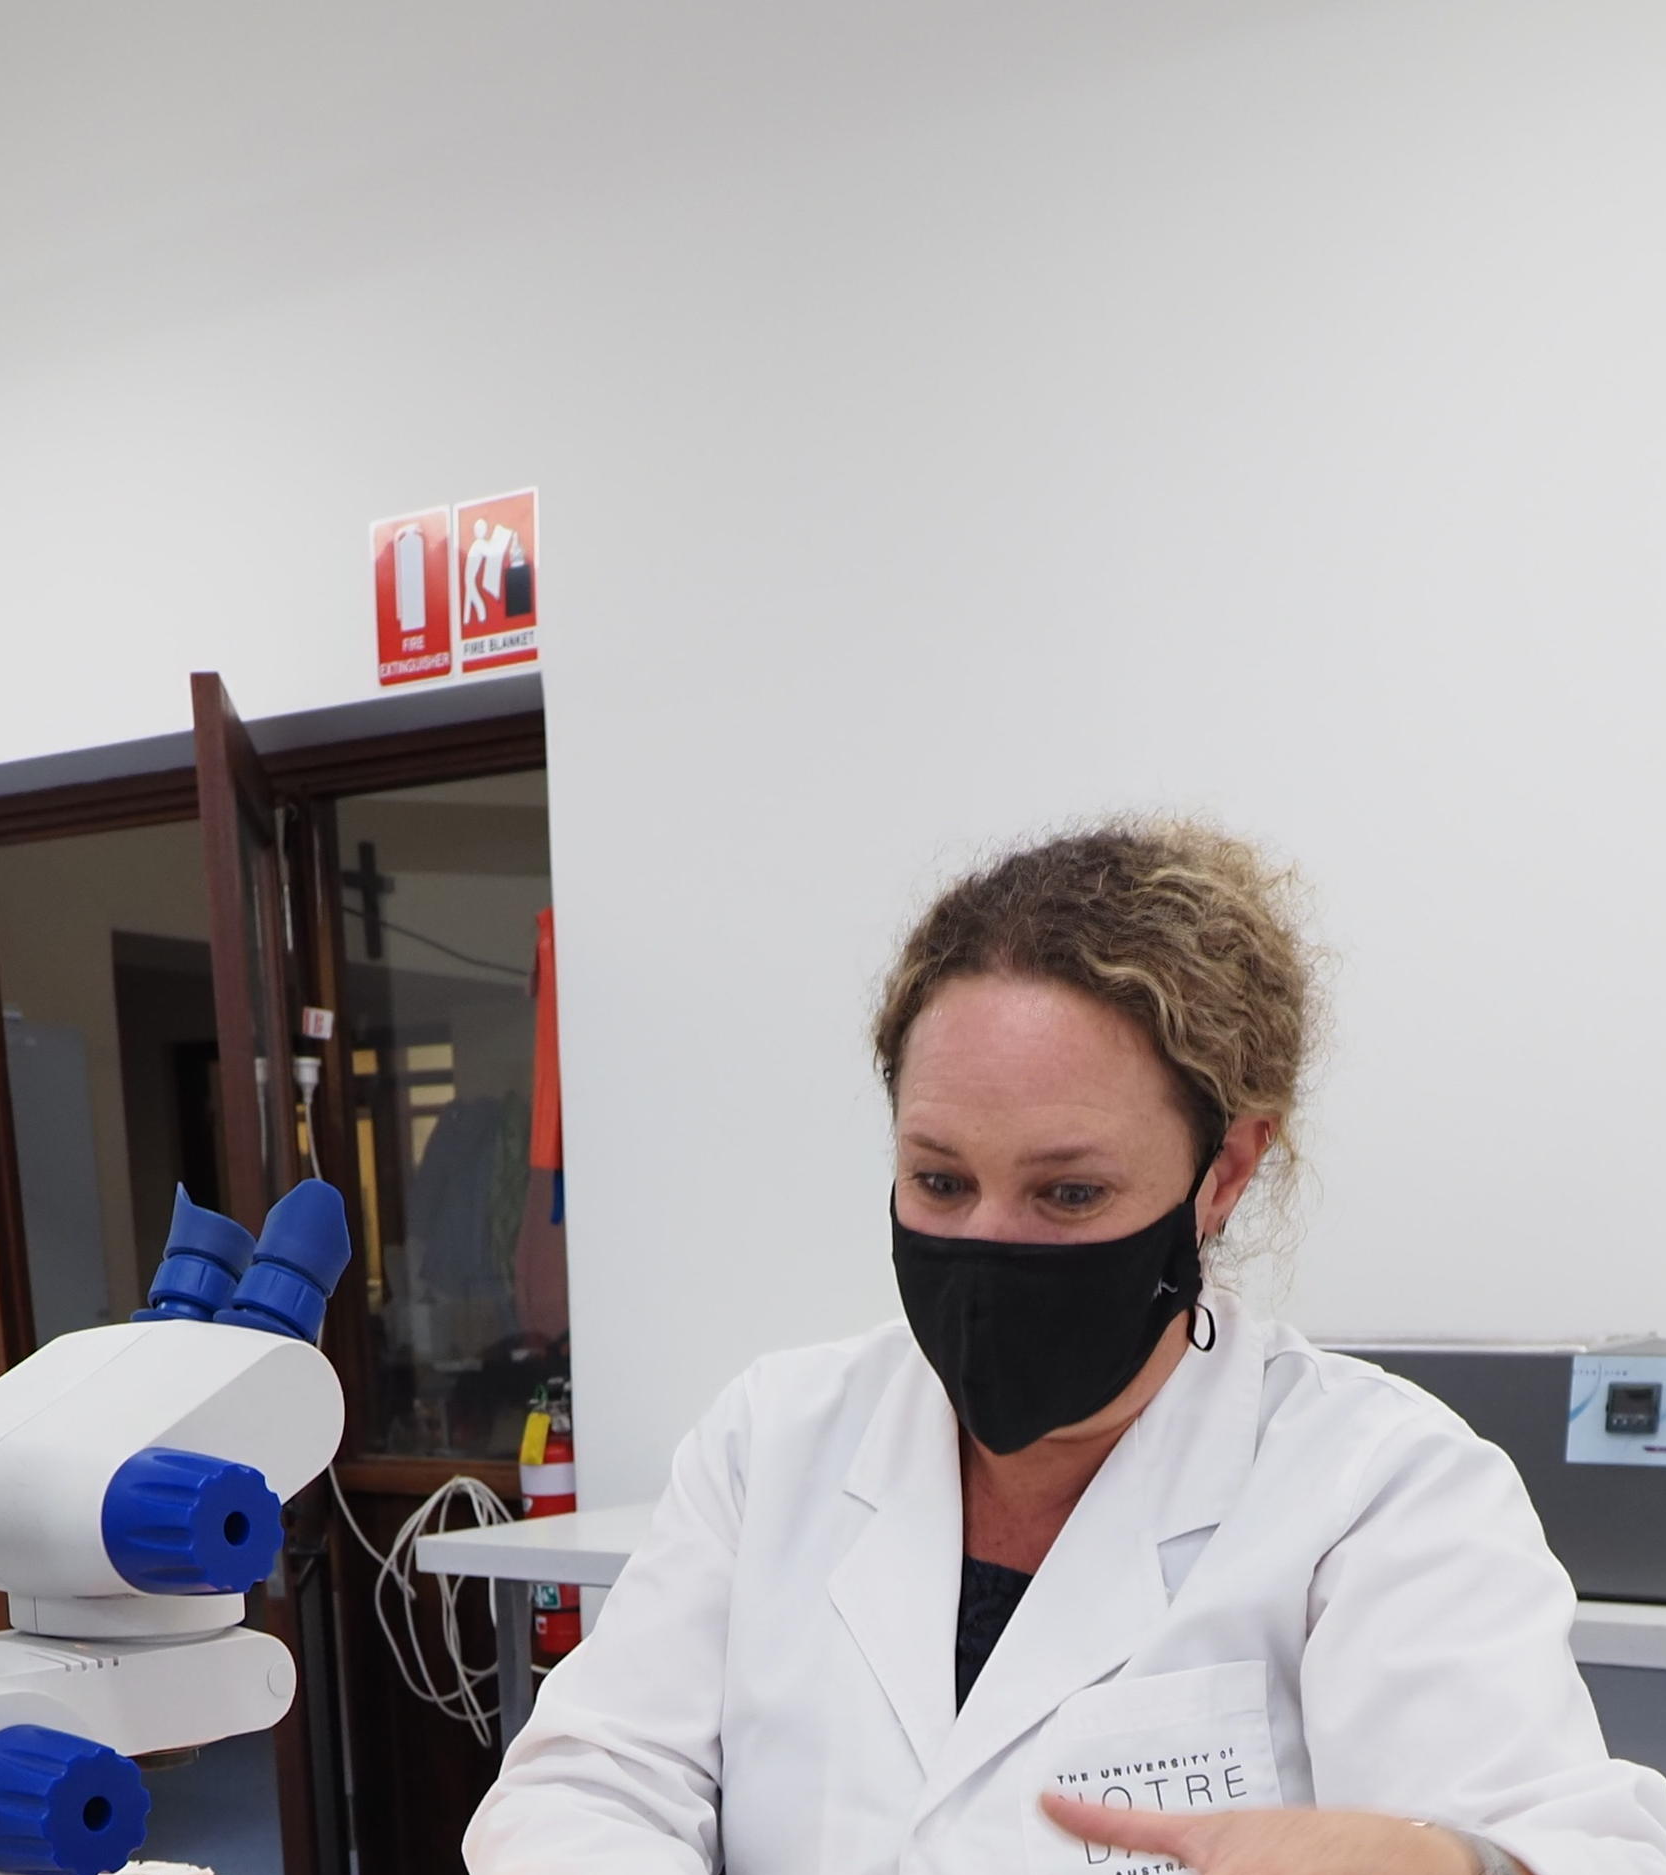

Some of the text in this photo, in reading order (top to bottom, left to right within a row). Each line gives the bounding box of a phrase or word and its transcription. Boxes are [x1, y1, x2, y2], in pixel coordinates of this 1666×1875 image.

[403, 636, 424, 651] FIRE
[463, 631, 535, 656] FIRE BLANKET
[380, 652, 451, 675] EXTINGUISHER
[1057, 1772, 1089, 1785] THE
[1101, 1753, 1210, 1779] UNIVERSITY
[1058, 1765, 1247, 1811] OTRE
